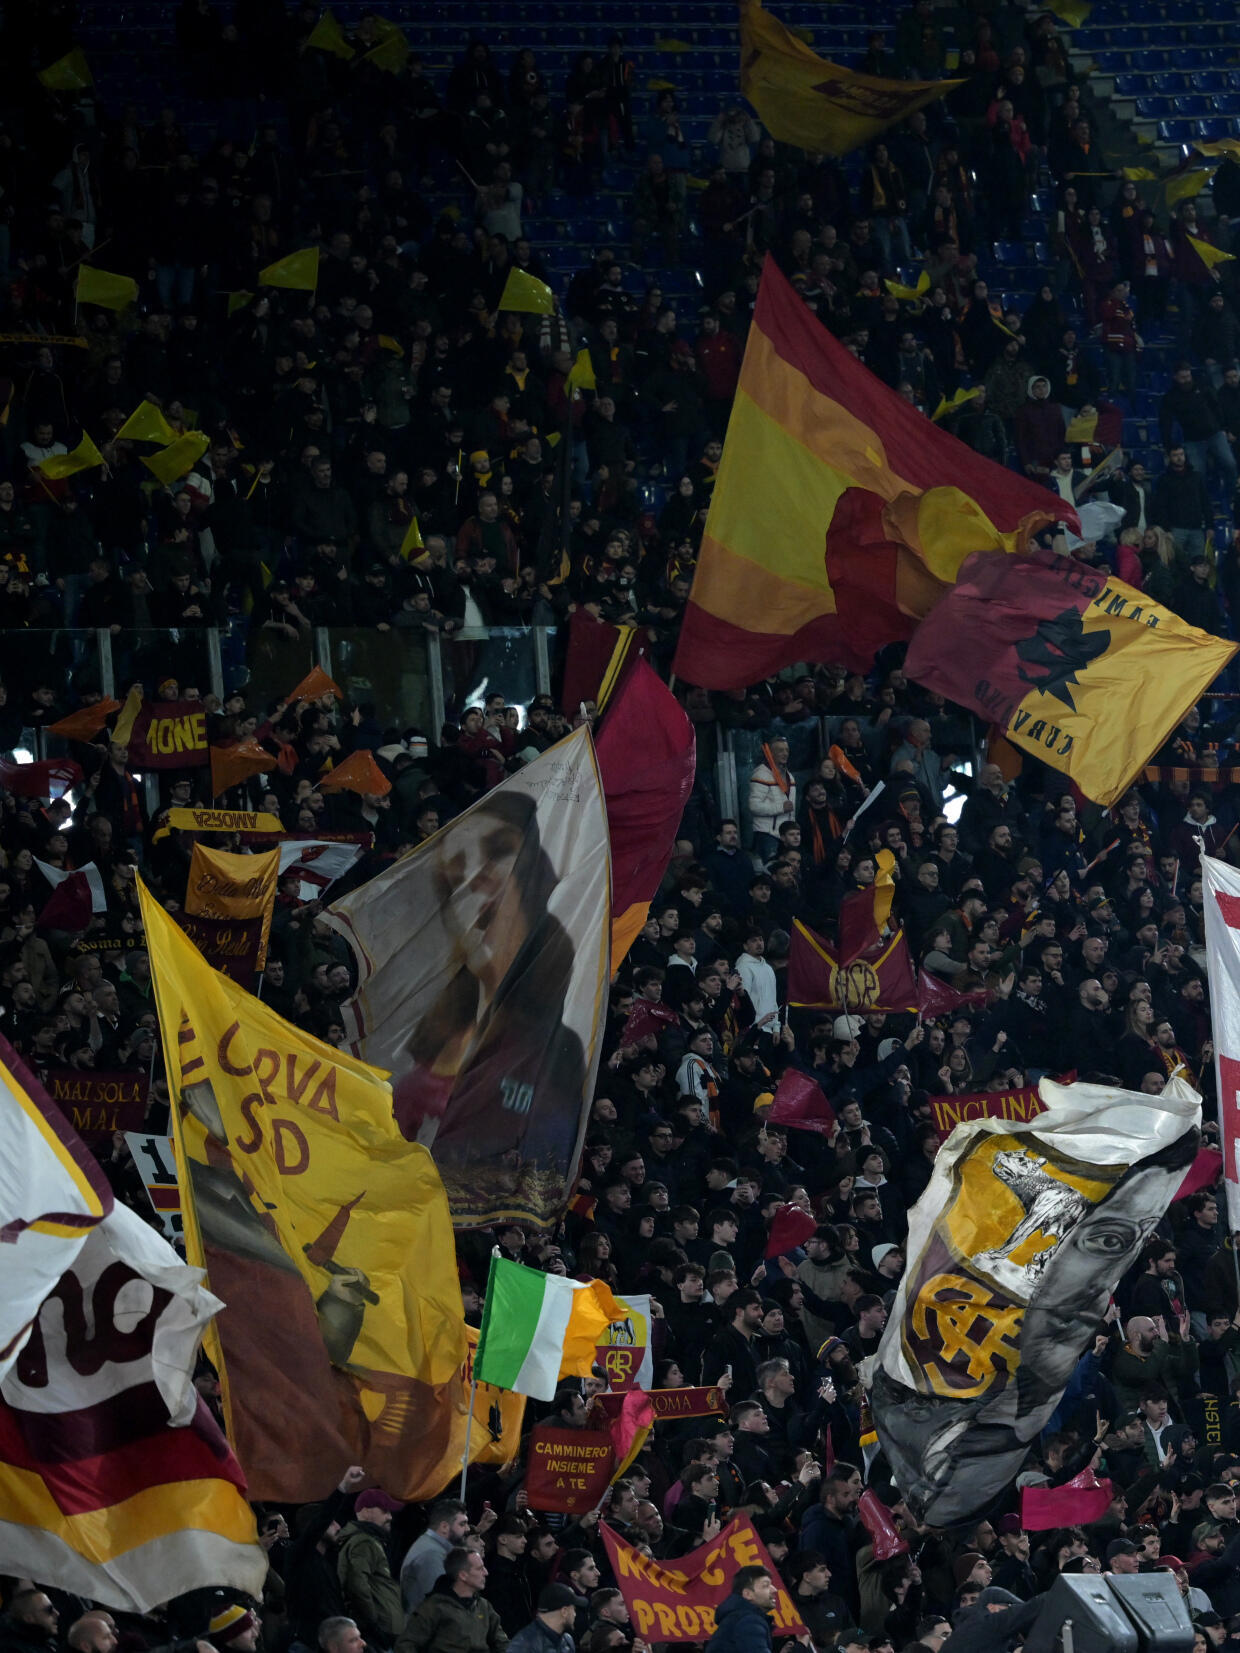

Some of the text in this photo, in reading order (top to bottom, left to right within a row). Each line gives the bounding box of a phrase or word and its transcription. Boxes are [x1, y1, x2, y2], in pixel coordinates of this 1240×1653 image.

[95, 1081, 141, 1103] SOLA
[72, 1106, 120, 1132] MAI
[547, 1460, 596, 1474] INSIEME
[556, 1479, 587, 1490] A TE
